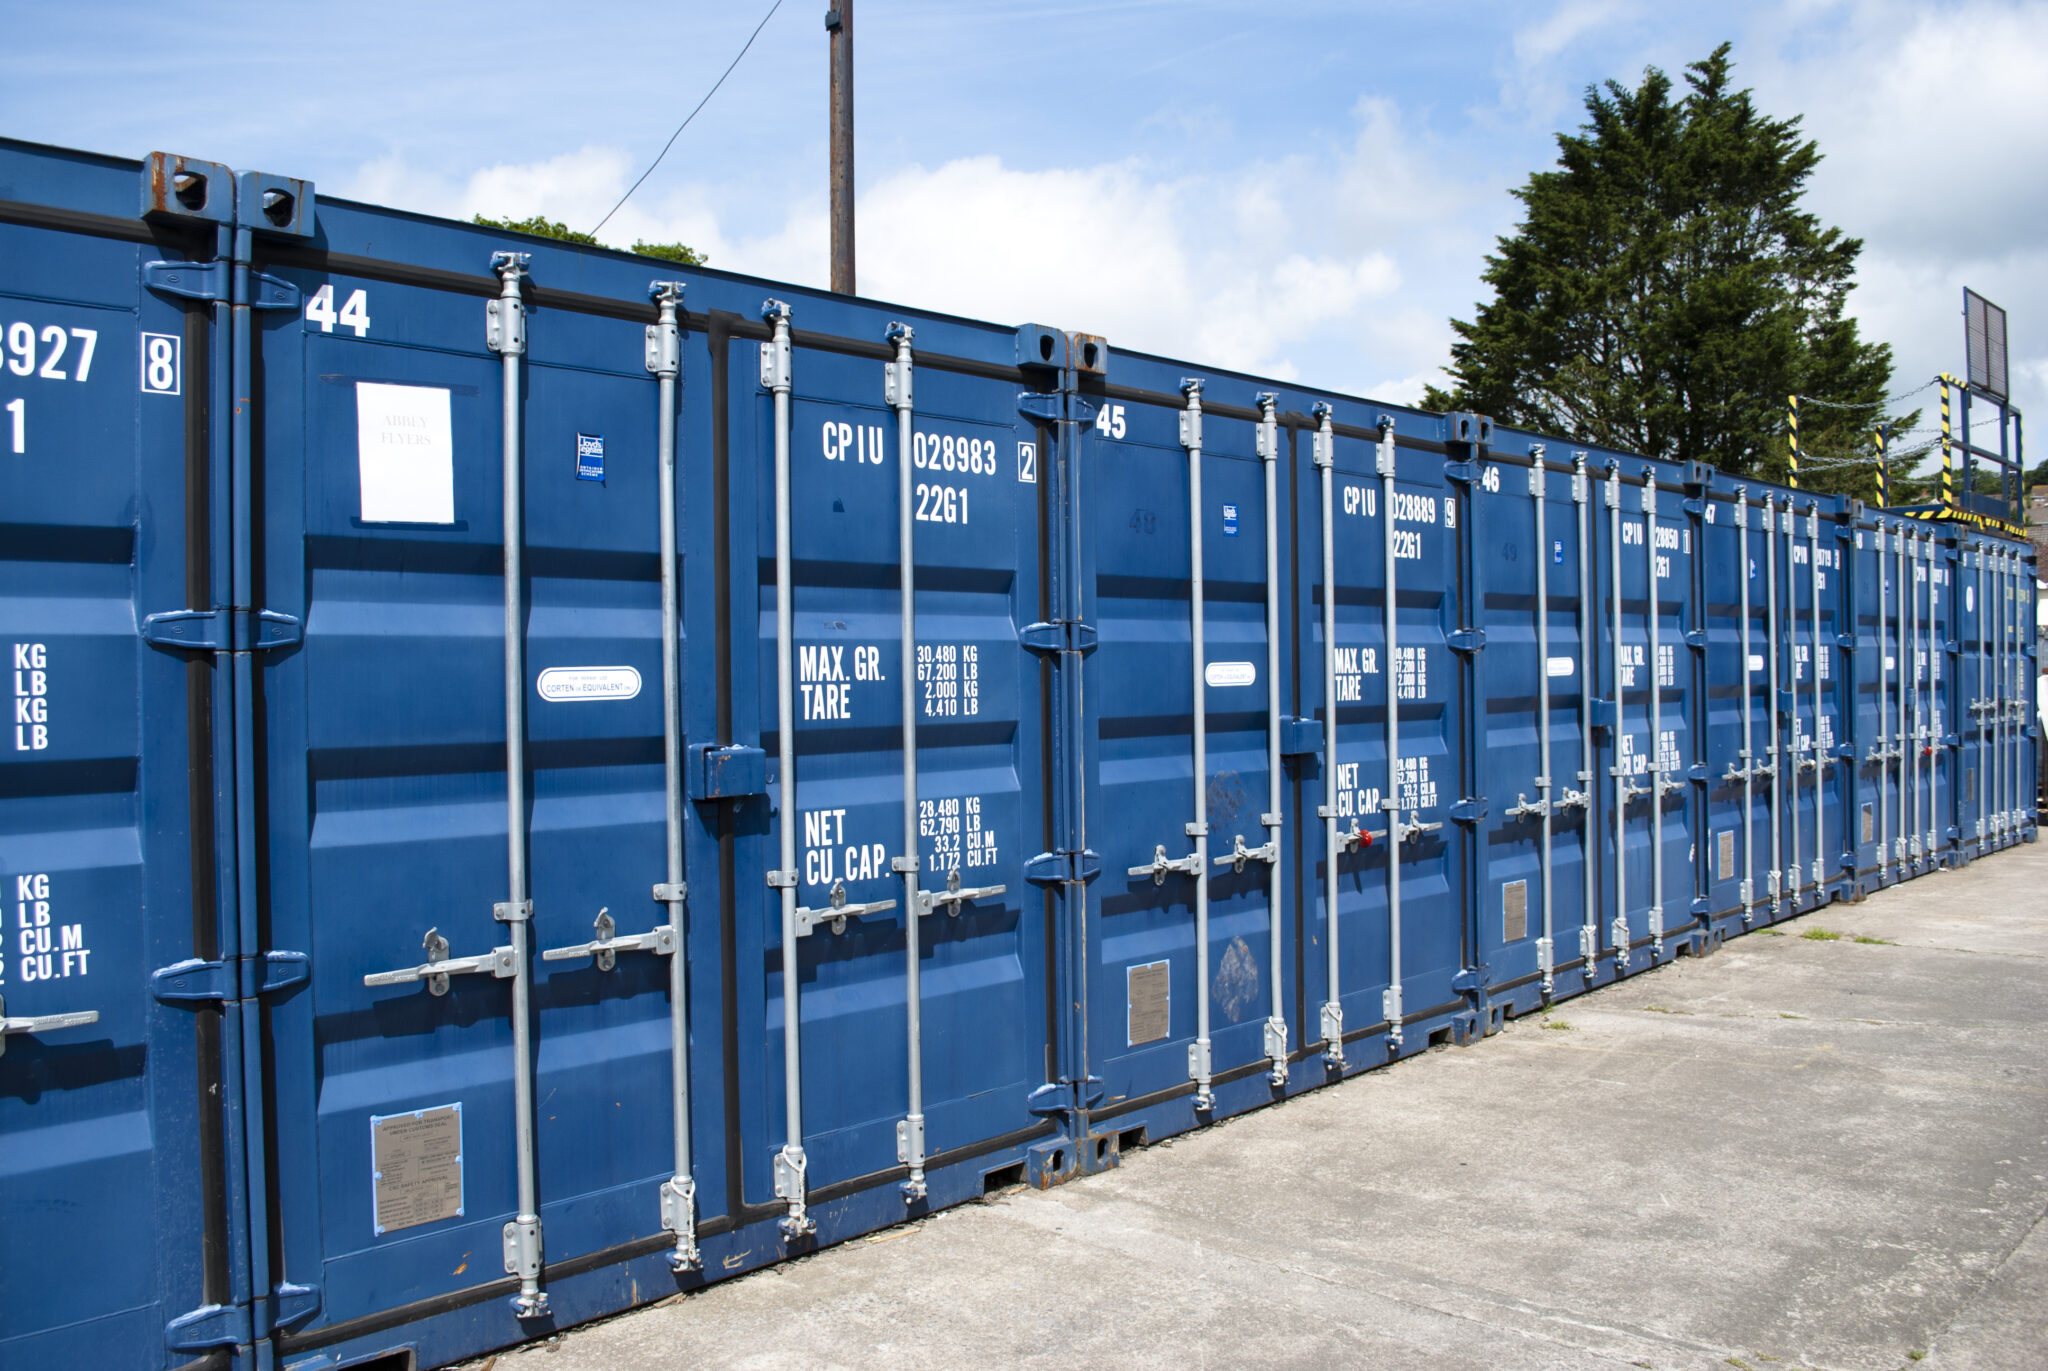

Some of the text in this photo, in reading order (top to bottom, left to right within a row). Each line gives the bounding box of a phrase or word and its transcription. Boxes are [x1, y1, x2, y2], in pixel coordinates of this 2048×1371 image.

[306, 285, 370, 337] 44
[0, 321, 174, 390] 927 8
[1097, 404, 1125, 439] 45
[381, 432, 432, 446] FLYERS
[822, 421, 1033, 480] CPIU 028983 2
[1482, 466, 1500, 492] 46
[915, 483, 968, 524] 22G1
[1344, 486, 1375, 517] CPIU
[1446, 500, 1454, 527] 9
[1705, 504, 1715, 524] 47
[1393, 530, 1421, 559] 22G1
[1623, 522, 1642, 545] CPIU
[1656, 526, 1678, 549] 28850
[1656, 556, 1669, 578] 2G1
[15, 644, 46, 669] KG
[800, 646, 885, 682] MAX. GR.
[917, 646, 977, 663] 30,480 KG
[1335, 648, 1378, 674] MAX. GR.
[15, 670, 47, 697] LB
[917, 663, 977, 681] 67,200 LB
[1621, 667, 1634, 686] ARE
[546, 684, 574, 693] CORTEN
[582, 683, 623, 691] EQUIVALENT
[925, 681, 978, 699] 2,000 KG
[1336, 676, 1361, 701] TARE
[15, 698, 47, 724] KG
[800, 684, 851, 720] TARE
[925, 699, 978, 717] 4,410 LB
[16, 724, 48, 751] LB
[1337, 763, 1358, 790] NET
[920, 797, 980, 819] 28,480 KG
[1338, 788, 1380, 817] CU. CAP.
[805, 809, 846, 847] NET
[920, 815, 981, 837] 62,790 LB
[935, 831, 994, 853] 33.2 CU.M
[845, 844, 890, 881] CAP.
[967, 848, 998, 867] CU.FT
[18, 874, 49, 900] KG
[19, 901, 50, 928] LB
[20, 924, 82, 955] CU.M
[22, 950, 90, 981] CU.FT
